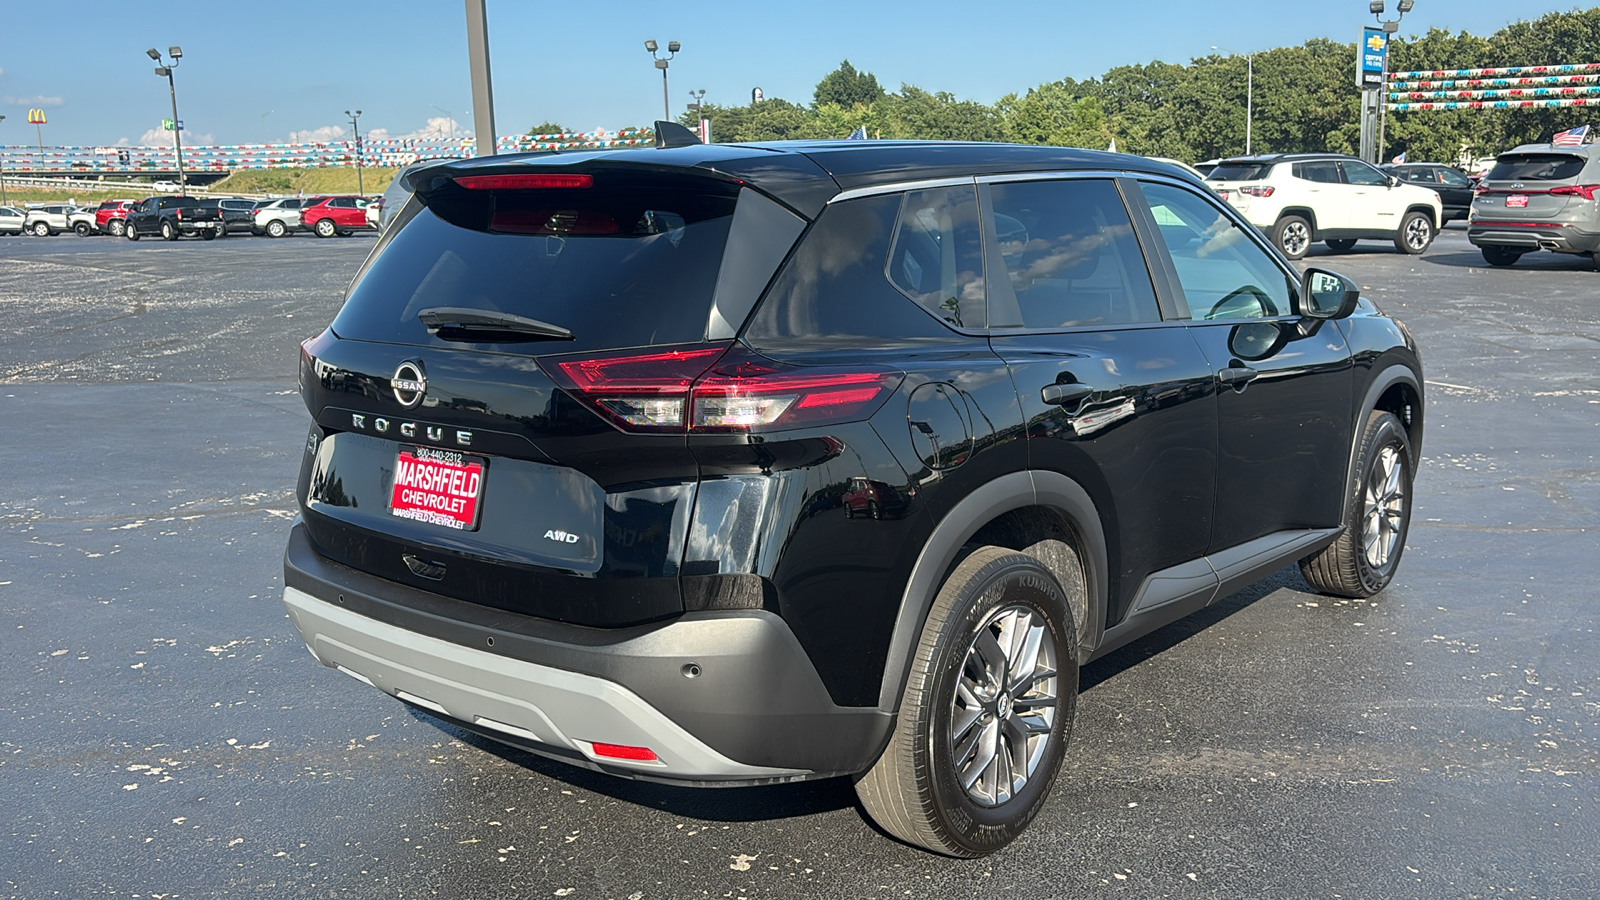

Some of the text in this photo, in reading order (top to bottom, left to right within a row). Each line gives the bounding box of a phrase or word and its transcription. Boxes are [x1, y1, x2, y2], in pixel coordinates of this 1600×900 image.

[391, 380, 424, 392] NISSAN
[352, 413, 473, 445] ROGUE
[417, 448, 463, 463] 800-440-2312
[395, 460, 480, 498] MARSHFIELD
[401, 489, 466, 513] CHEVROLET
[543, 529, 579, 543] AWD
[1019, 575, 1057, 601] KUMHO
